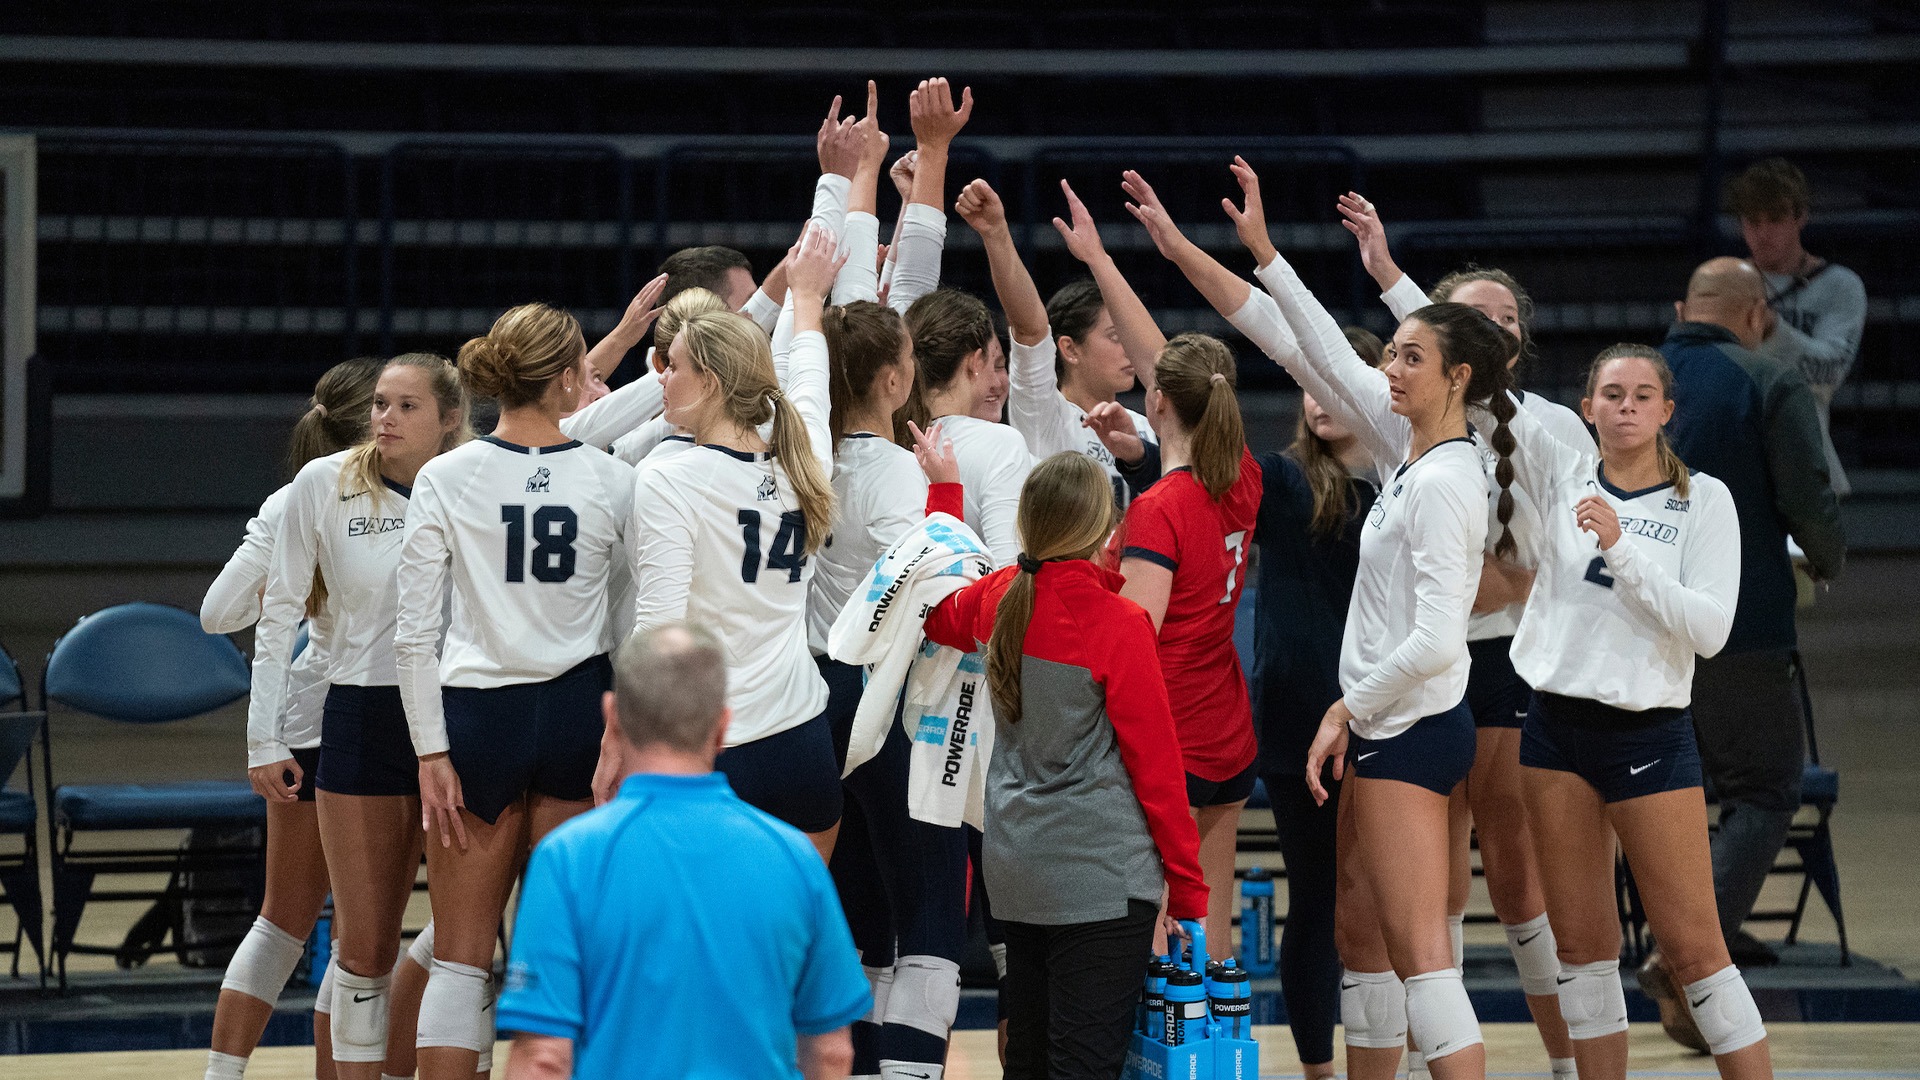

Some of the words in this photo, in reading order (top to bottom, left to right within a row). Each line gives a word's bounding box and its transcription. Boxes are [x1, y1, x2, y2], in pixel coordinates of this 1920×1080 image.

[499, 503, 579, 584] 18
[737, 507, 808, 584] 14
[1218, 530, 1248, 605] 7
[941, 682, 975, 787] POWERADE
[1214, 1003, 1250, 1012] POWERADE
